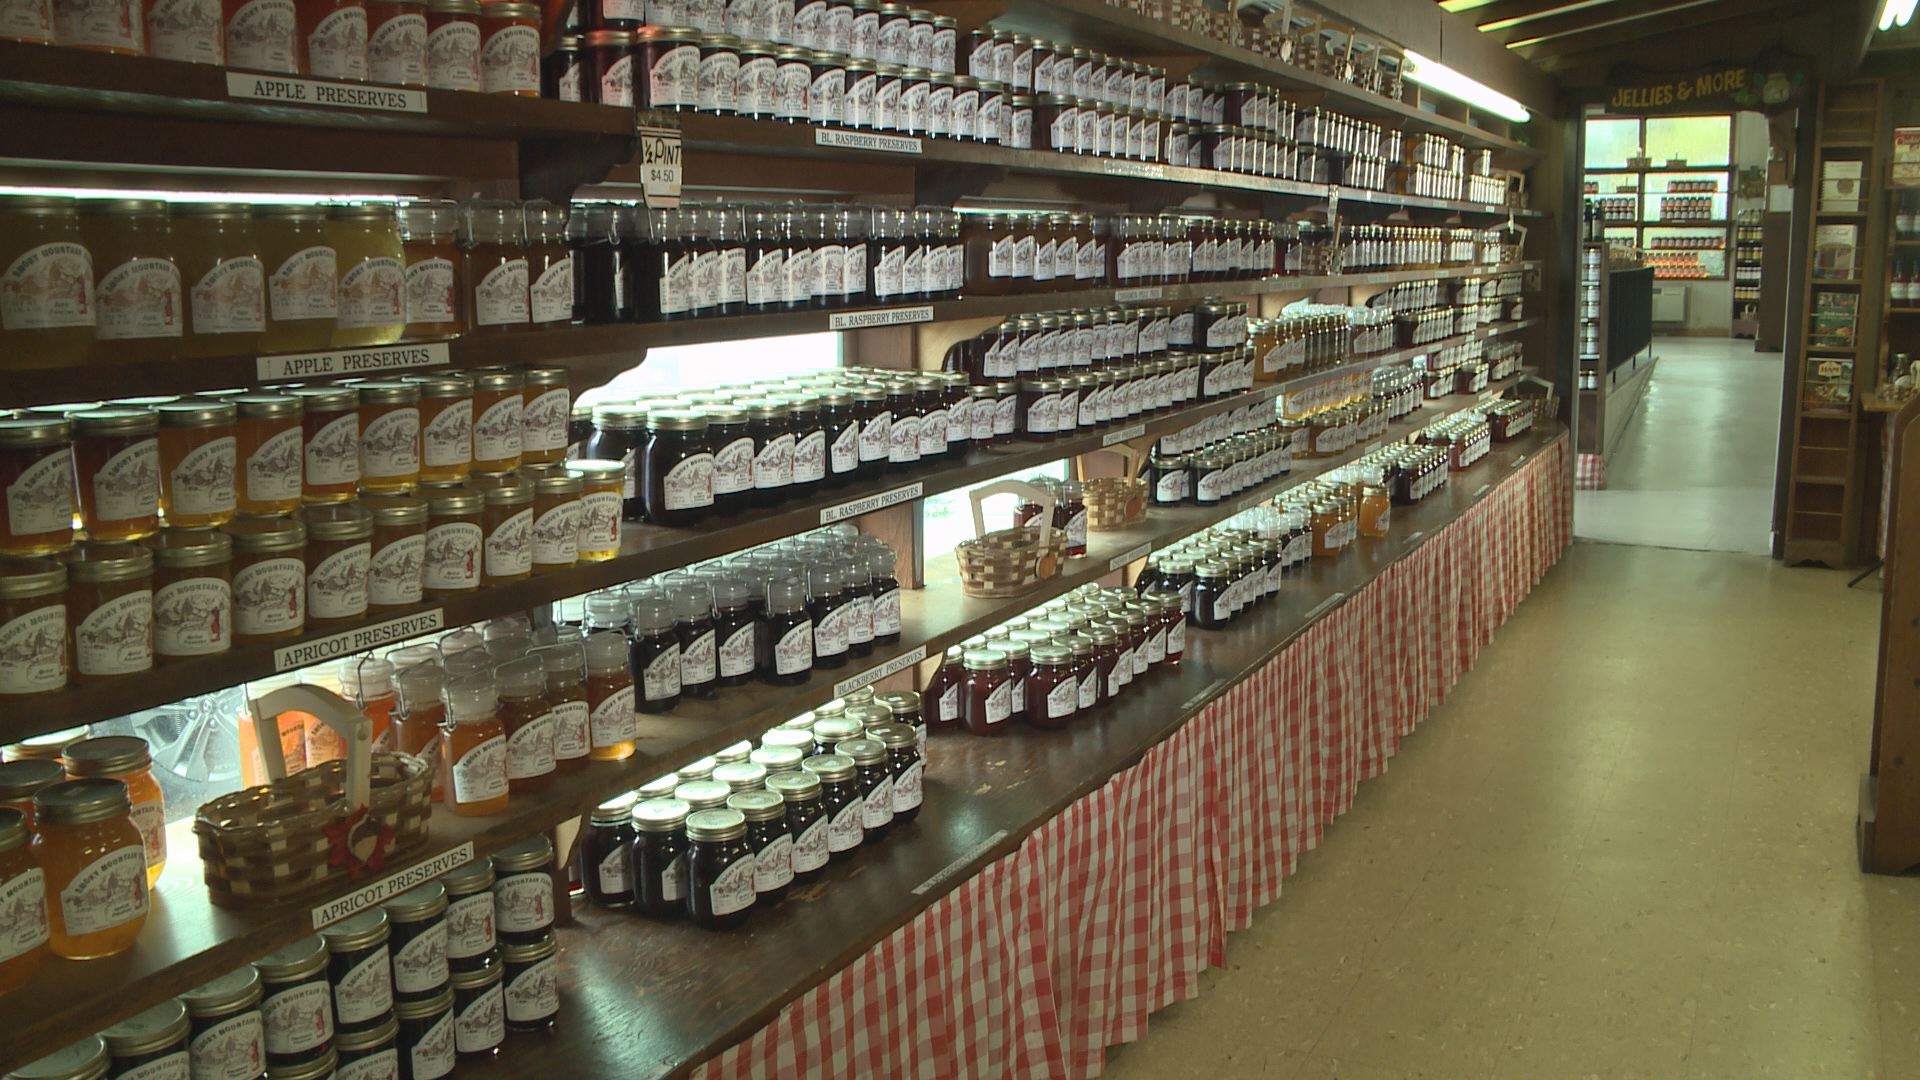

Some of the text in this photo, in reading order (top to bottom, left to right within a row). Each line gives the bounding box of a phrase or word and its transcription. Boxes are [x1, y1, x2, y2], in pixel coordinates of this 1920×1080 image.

[254, 80, 408, 109] APPLE PRESERVES
[1612, 68, 1746, 107] JELLIES & MORE
[654, 138, 681, 166] PINT
[821, 132, 918, 151] BL. RASPBERRY PRESERVES
[650, 169, 674, 182] $4.50
[835, 309, 929, 328] BL. RASPBERRY PRESERVES
[283, 349, 430, 376] APPLE PRESERVES
[825, 486, 919, 521] BL. RASPBERRY PRESERVES
[283, 613, 437, 667] APRICOT PRESERVES
[838, 650, 922, 695] BLACKBERRY PRESERVES
[320, 848, 469, 925] APRICOT PRESERVES
